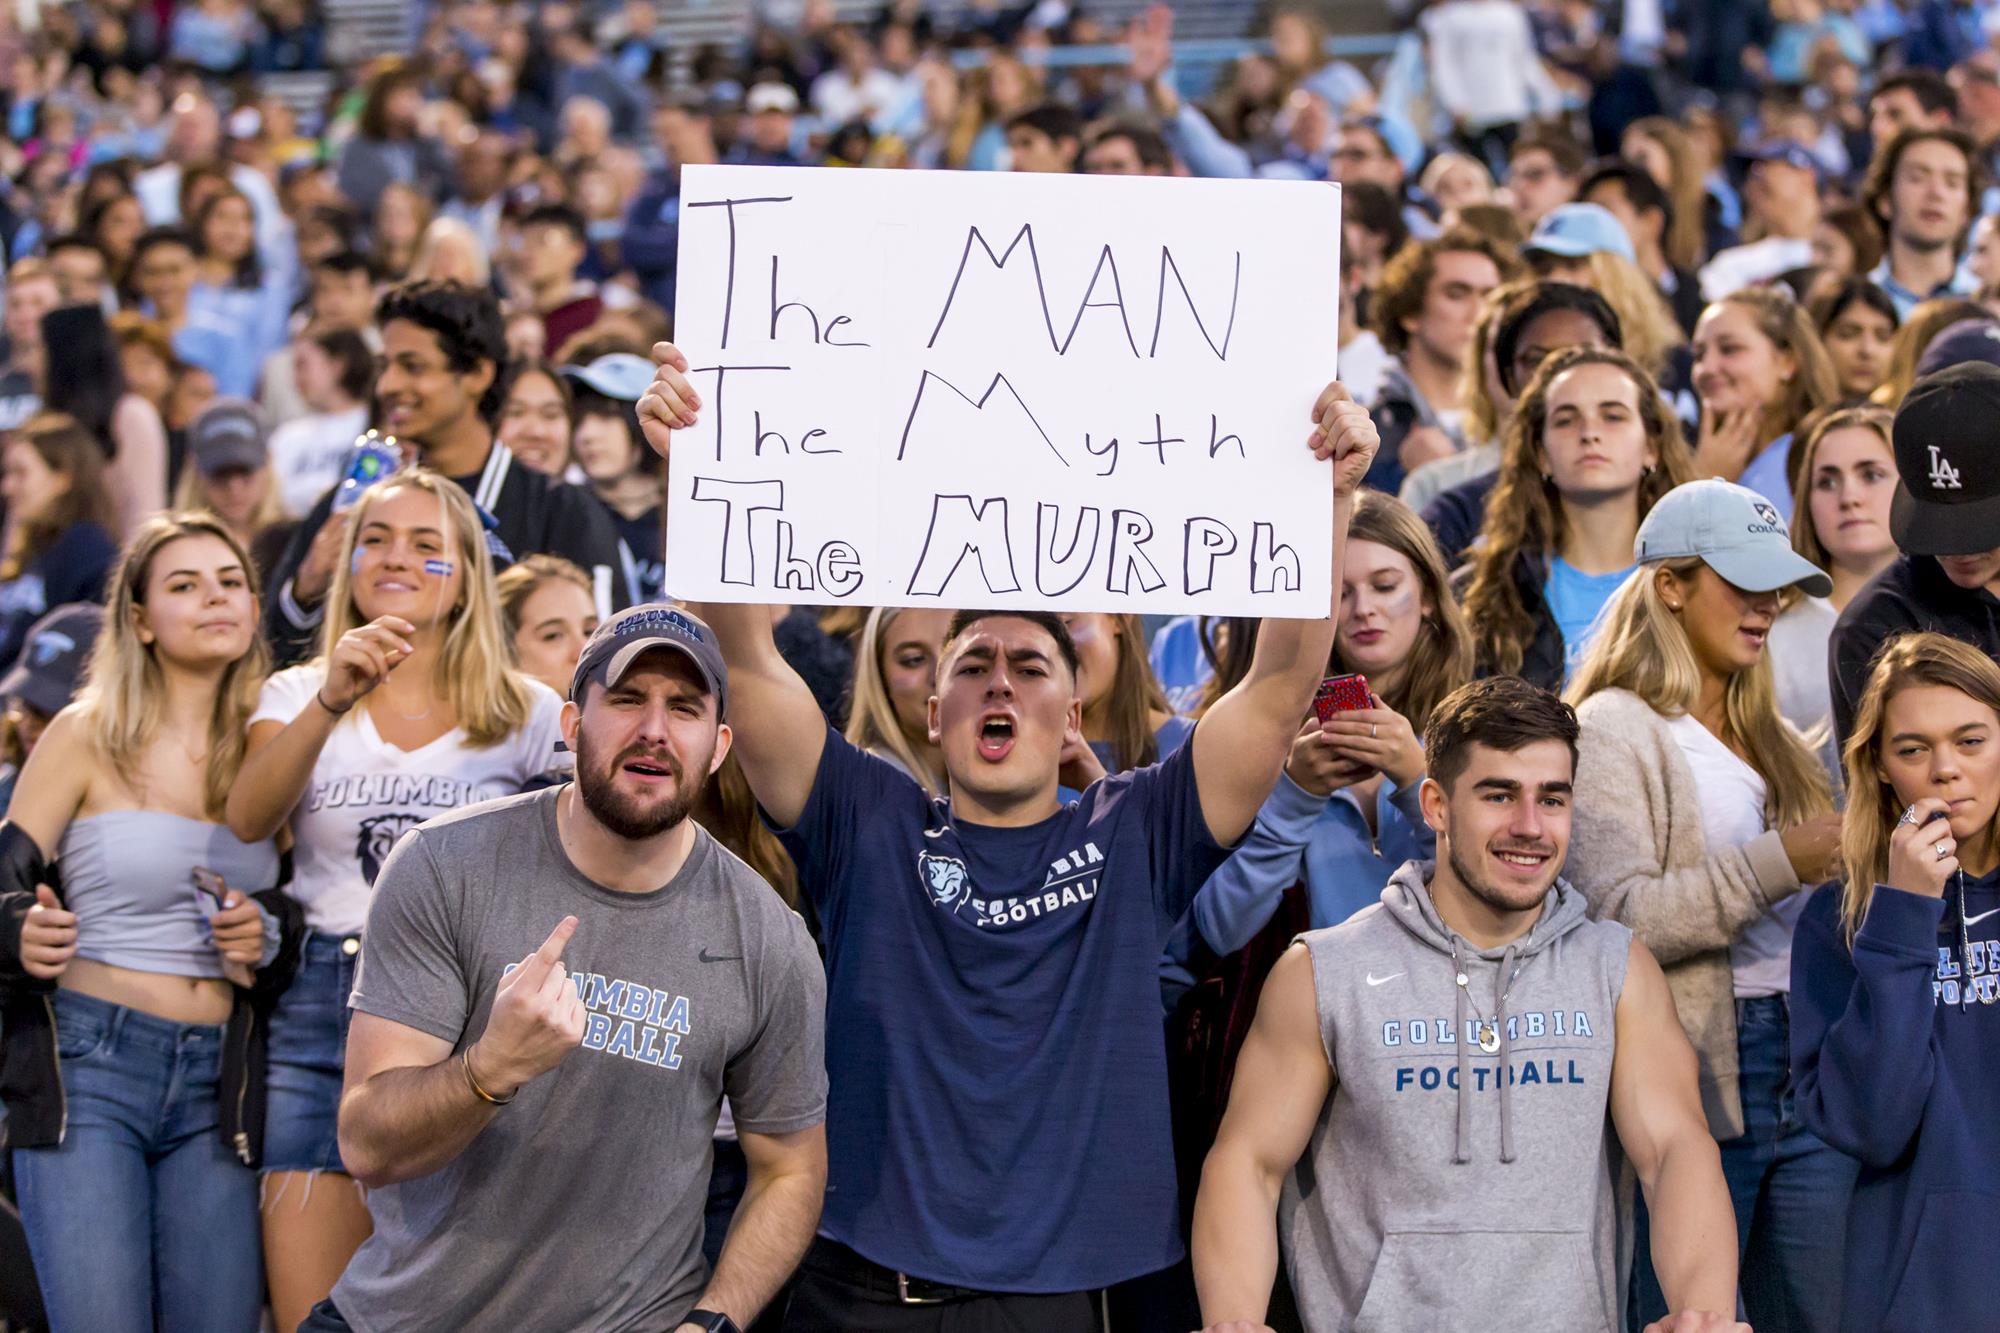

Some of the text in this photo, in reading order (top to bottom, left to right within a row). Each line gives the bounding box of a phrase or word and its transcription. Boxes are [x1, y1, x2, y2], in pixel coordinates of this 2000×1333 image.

[688, 196, 1241, 361] The MAN
[692, 366, 1246, 477] The Myth
[1927, 445, 1962, 488] LA
[691, 476, 864, 598] The
[581, 1012, 683, 1070] BALL
